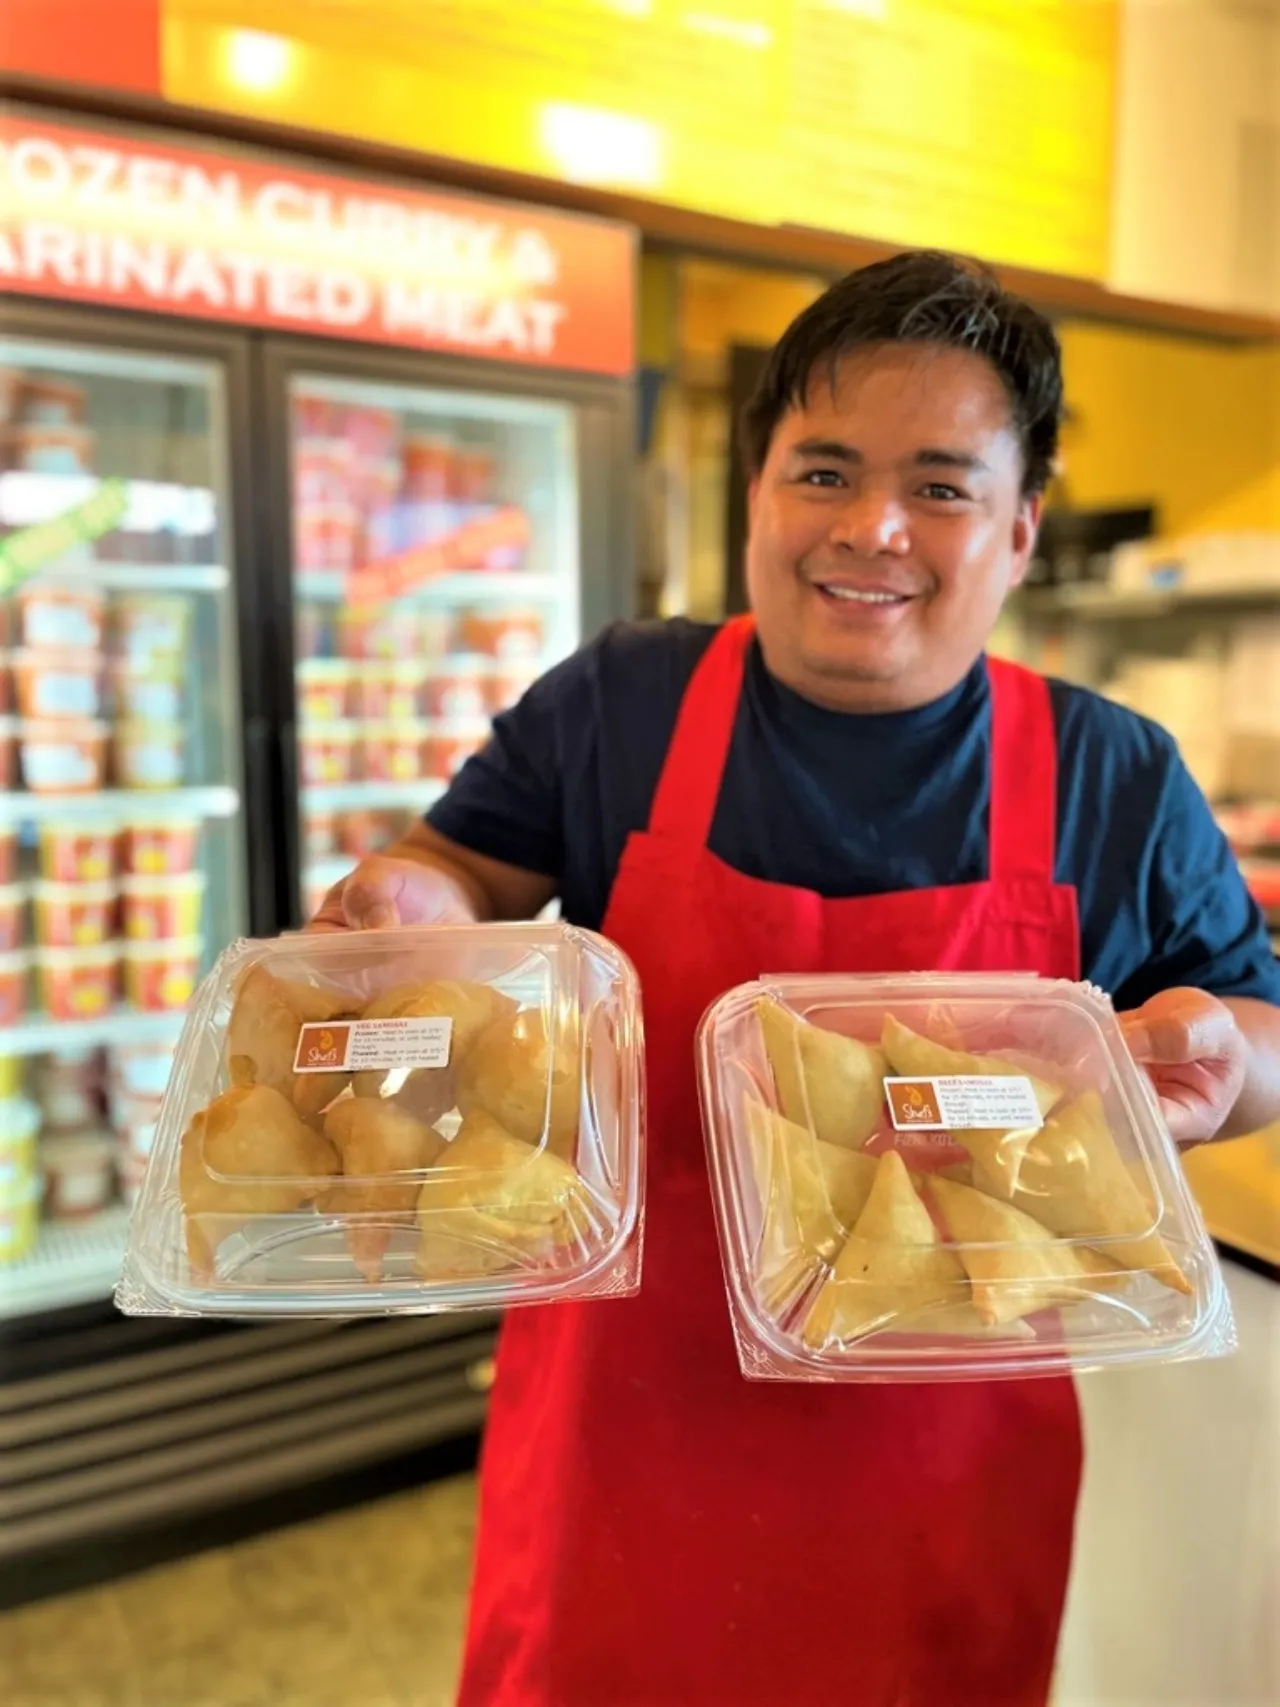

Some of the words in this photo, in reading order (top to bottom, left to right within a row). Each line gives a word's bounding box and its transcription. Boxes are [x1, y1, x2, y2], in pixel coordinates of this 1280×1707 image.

[0, 137, 240, 230] OZEN
[256, 181, 503, 277] CURRY
[512, 229, 558, 285] &
[381, 285, 565, 355] MEAT
